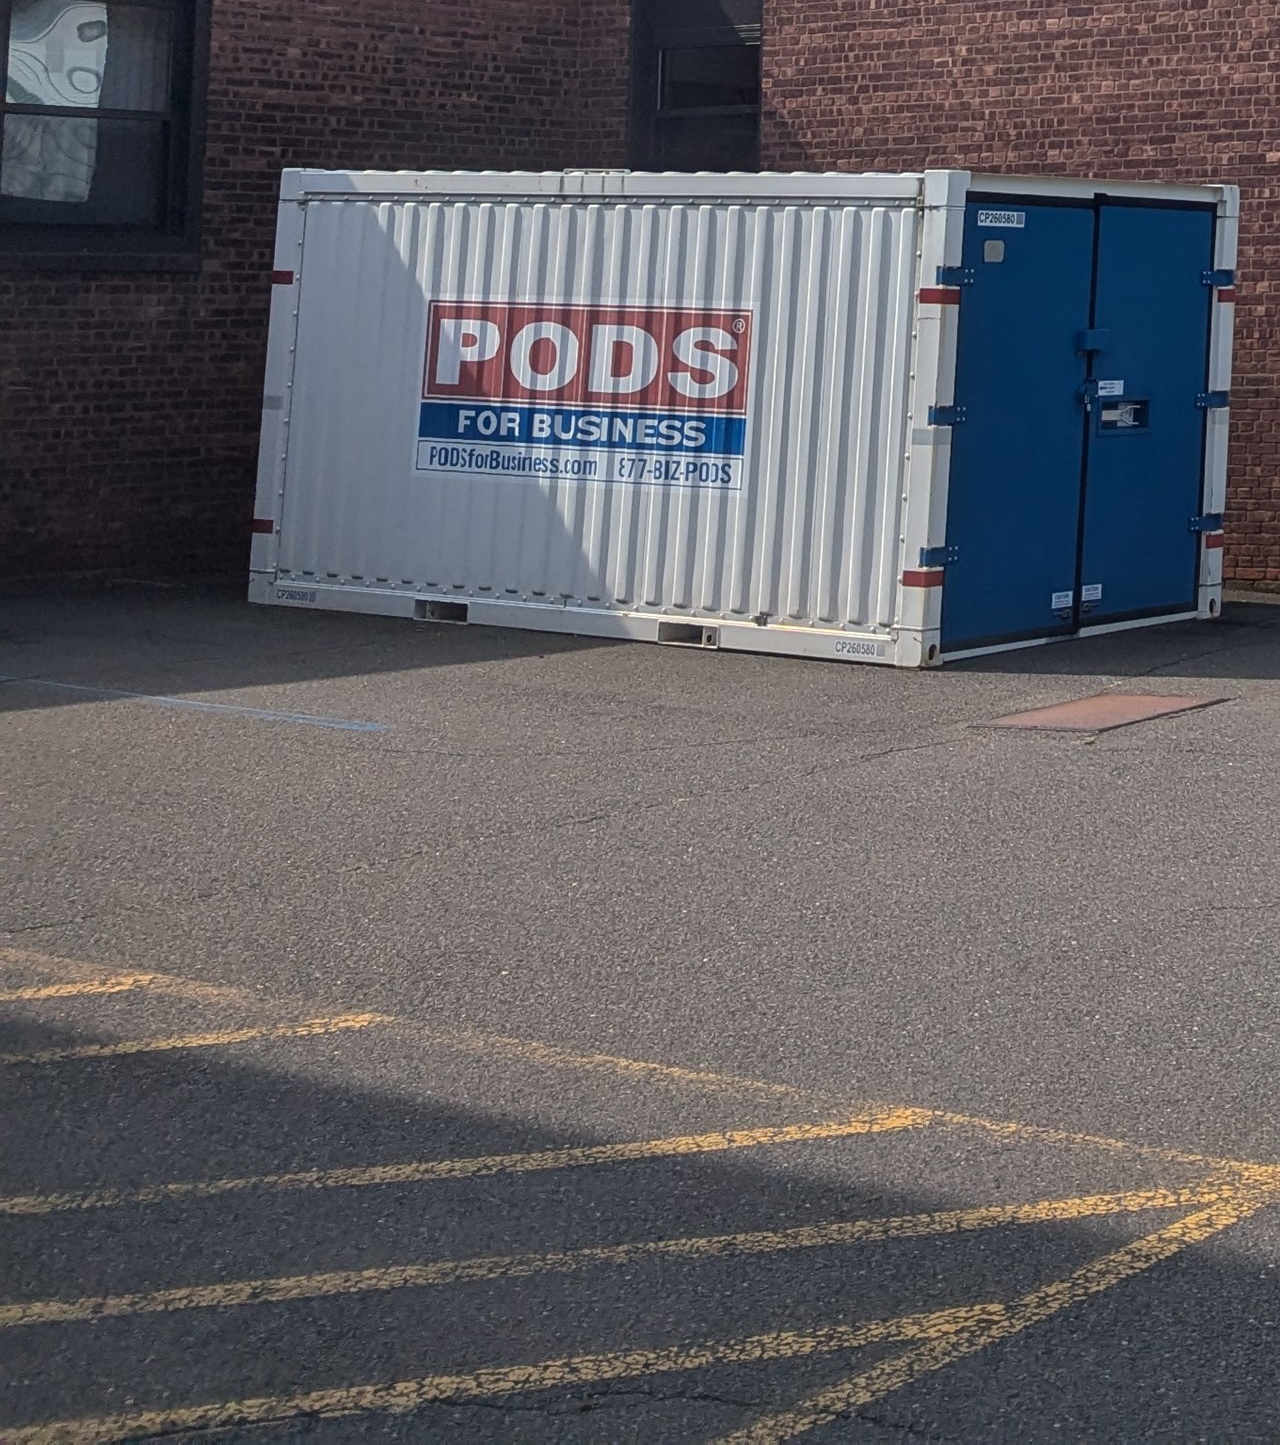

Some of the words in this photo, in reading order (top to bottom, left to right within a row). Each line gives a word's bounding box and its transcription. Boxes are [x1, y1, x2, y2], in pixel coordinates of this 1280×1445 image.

[435, 318, 739, 399] PODS
[457, 409, 520, 437] FOR
[531, 413, 707, 447] BUSINESS
[429, 445, 598, 476] PODSforBusiness.com
[834, 641, 876, 656] CP260580
